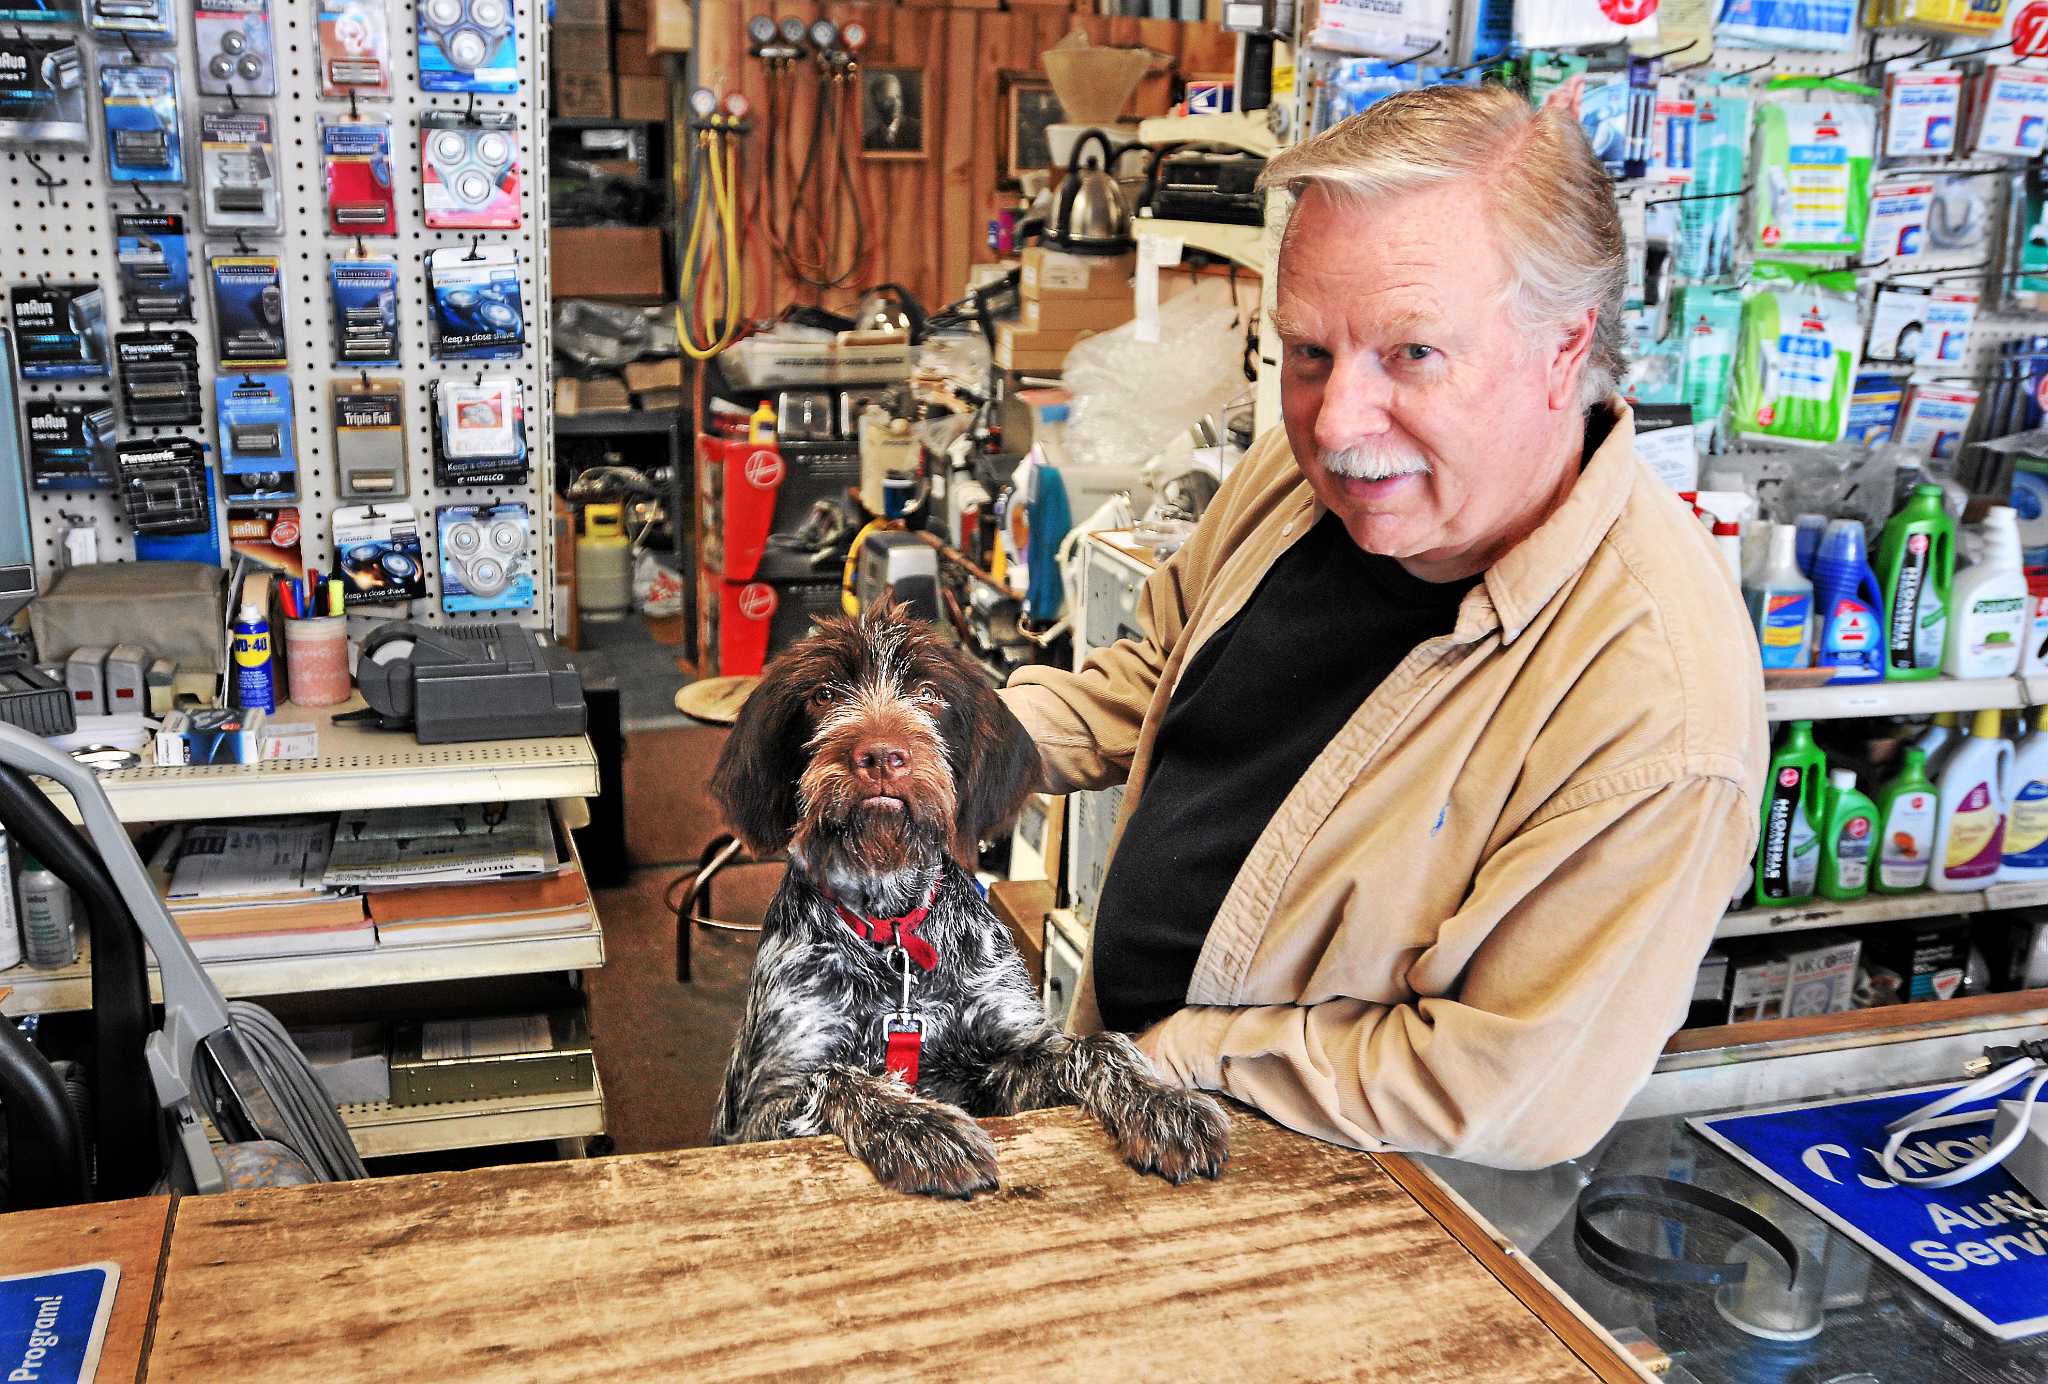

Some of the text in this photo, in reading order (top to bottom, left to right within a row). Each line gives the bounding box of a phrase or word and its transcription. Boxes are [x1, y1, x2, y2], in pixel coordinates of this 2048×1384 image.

[16, 300, 53, 316] BRAUN
[442, 335, 462, 344] Keep
[121, 343, 174, 354] Panasonic
[32, 414, 67, 430] BRAUN
[344, 411, 389, 426] Triple Foil
[120, 450, 175, 464] Panasonic
[232, 521, 264, 537] BRAUN
[1767, 799, 1789, 878] STRENGTH
[8, 1295, 63, 1382] Program!
